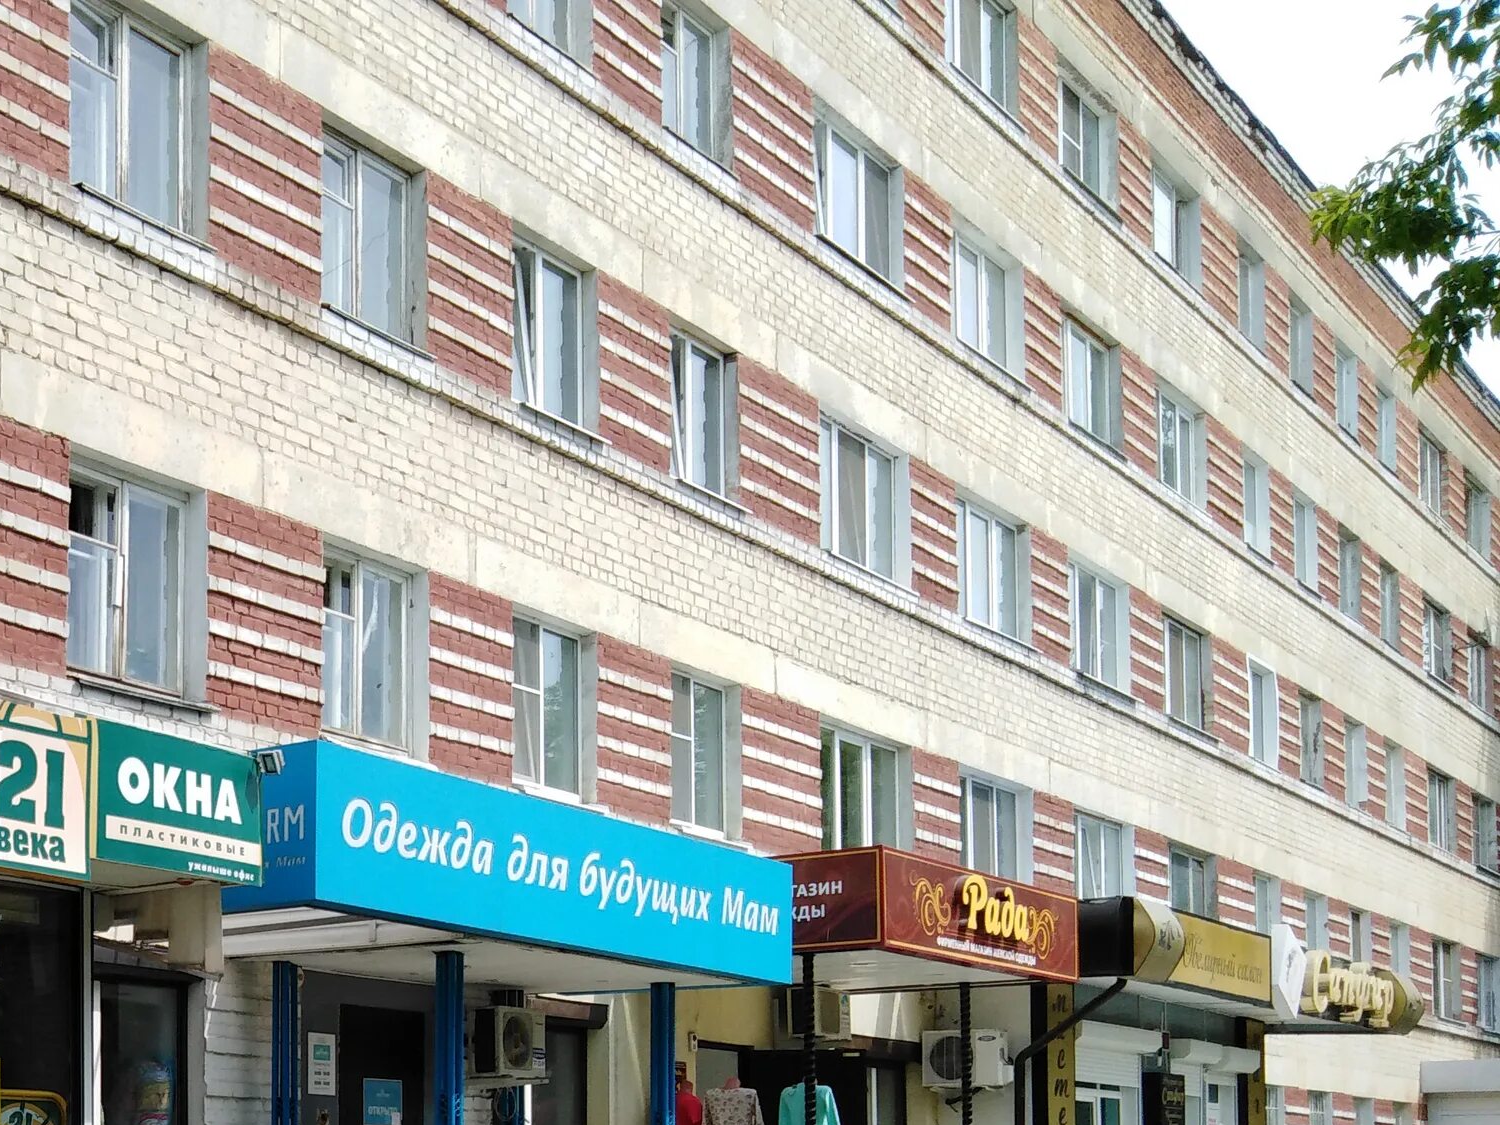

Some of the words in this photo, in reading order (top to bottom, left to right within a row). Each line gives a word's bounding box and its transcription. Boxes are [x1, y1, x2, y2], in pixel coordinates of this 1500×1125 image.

[117, 756, 243, 825] ОКНА
[119, 824, 246, 857] ПЛАСТИКОВЫЕ
[267, 804, 305, 844] RM
[233, 869, 255, 882] офис
[341, 797, 494, 876] Одежда
[506, 834, 569, 893] для
[578, 851, 712, 926] будущих
[721, 884, 780, 937] Мам
[792, 880, 843, 898] ГАЗИН
[962, 873, 1030, 942] Рада
